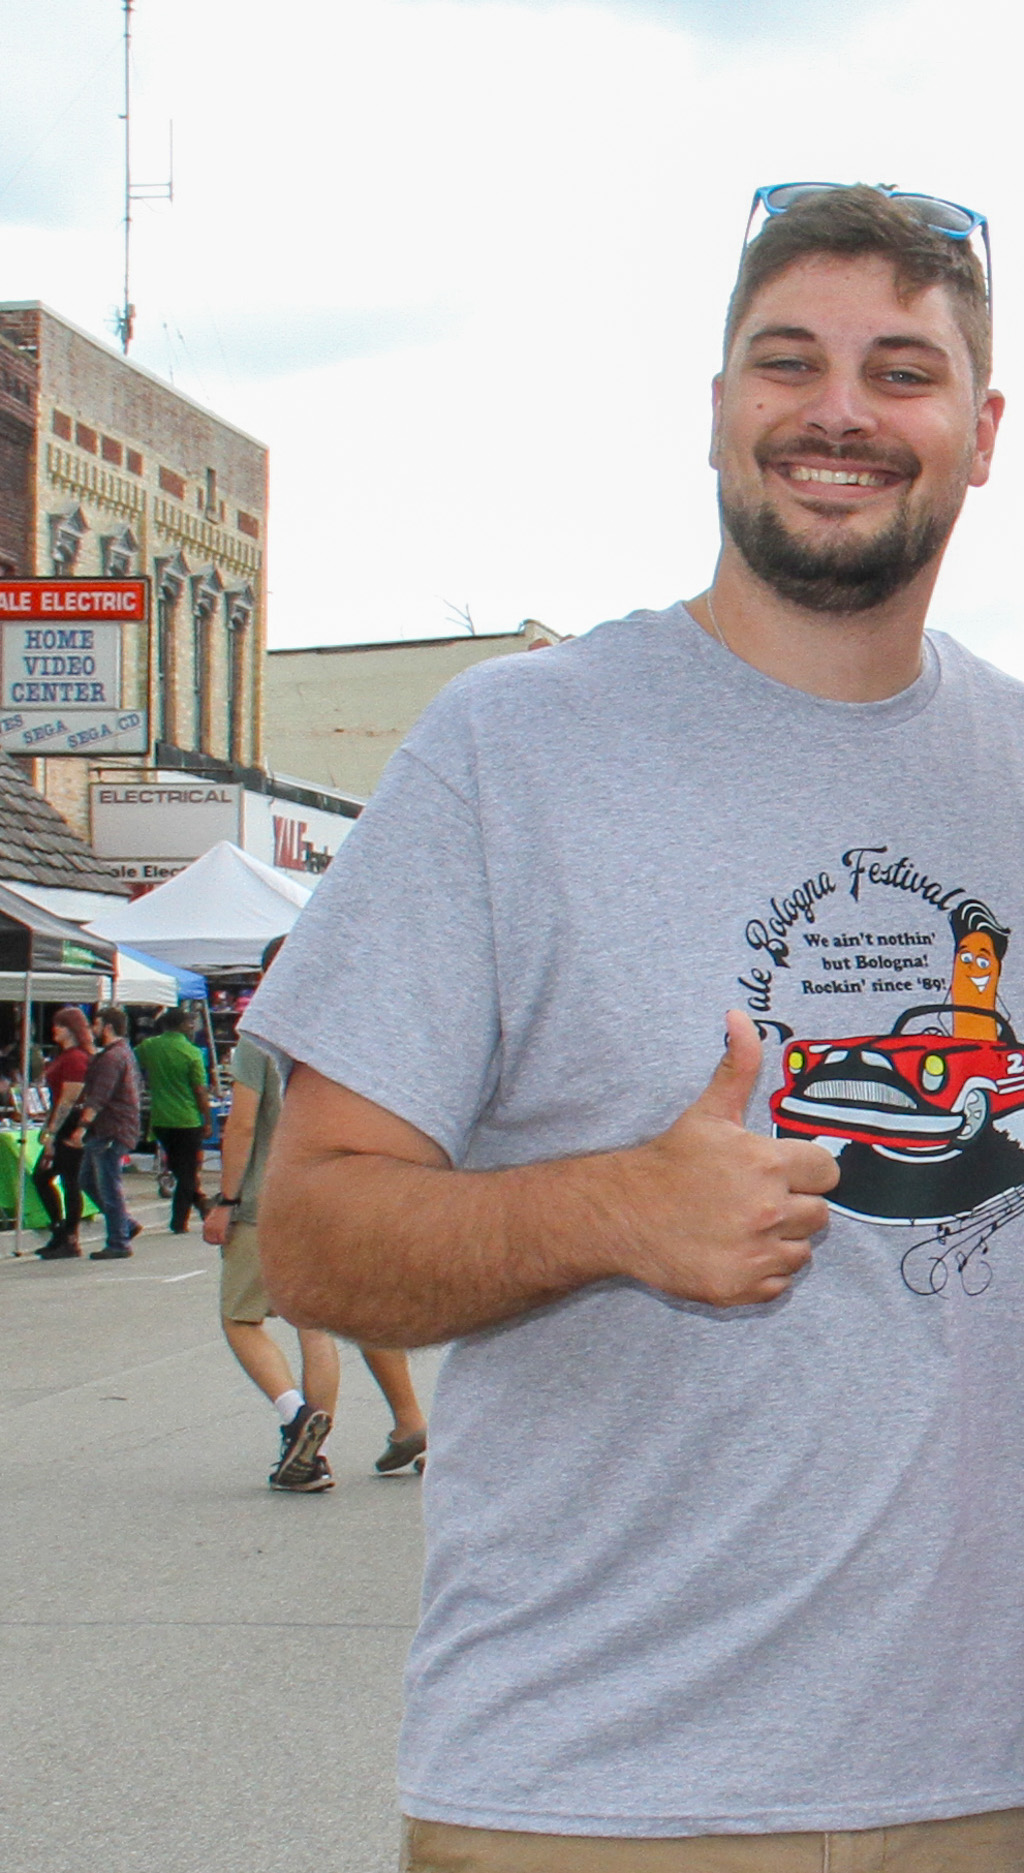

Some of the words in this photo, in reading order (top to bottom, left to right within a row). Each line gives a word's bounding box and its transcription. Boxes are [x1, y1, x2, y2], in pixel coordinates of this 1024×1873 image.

[40, 591, 138, 612] ELECTRIC
[24, 629, 95, 650] HOME
[23, 655, 96, 676] VIDEO
[11, 682, 106, 703] CENTER
[0, 714, 24, 732] ES
[23, 720, 68, 745] SEGA
[66, 723, 112, 749] SEGA
[117, 712, 141, 731] CD
[100, 789, 233, 805] ELECTRICAL
[143, 865, 187, 879] Elec
[745, 872, 836, 968] Bologna
[841, 845, 966, 911] Festival
[803, 933, 829, 948] We
[831, 932, 874, 948] ain't
[877, 932, 936, 947] nothin'
[822, 956, 851, 971] but
[855, 954, 929, 972] Bologna!
[802, 979, 866, 995] Rockin'
[872, 979, 912, 993] since
